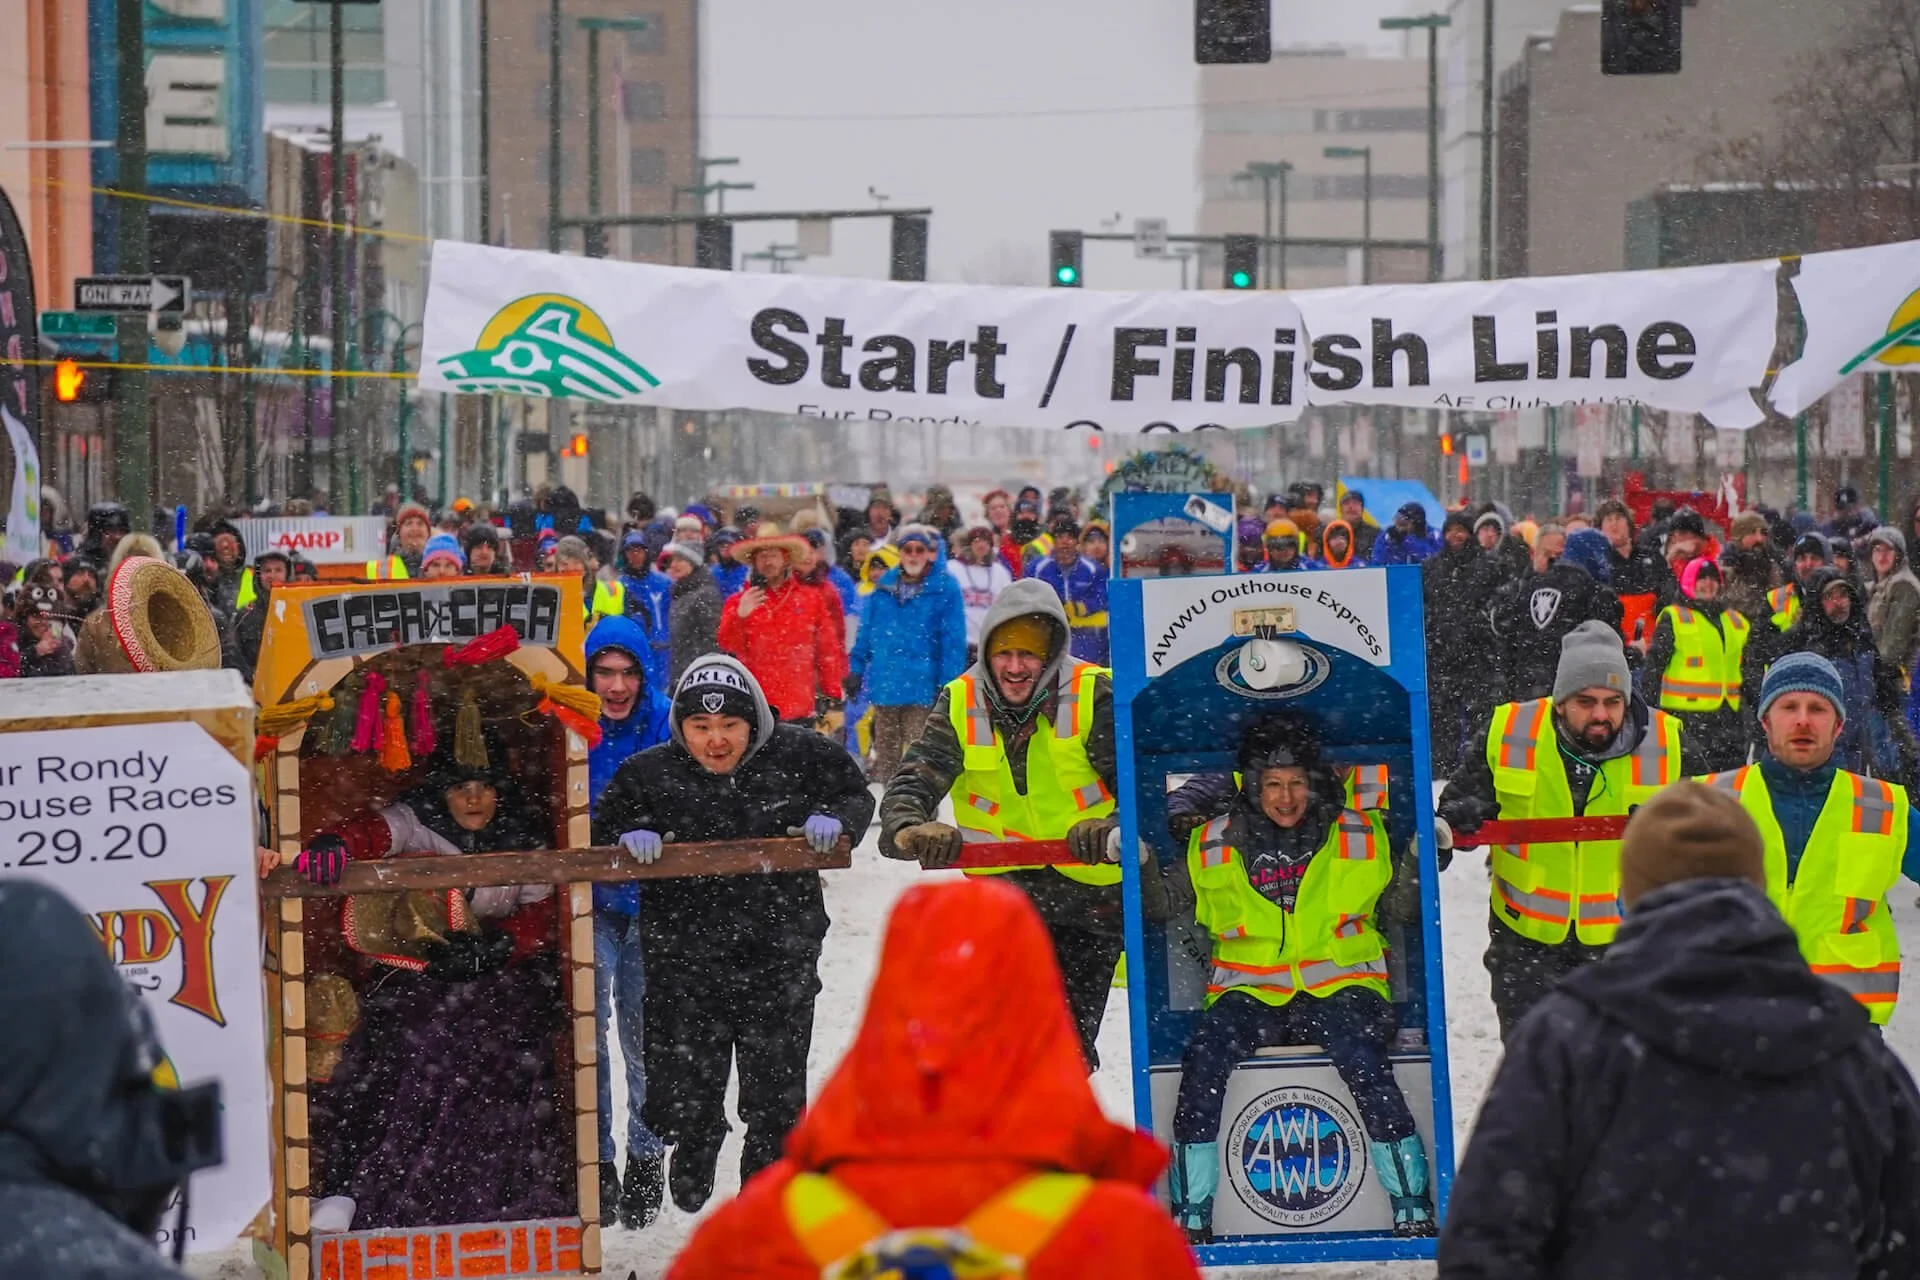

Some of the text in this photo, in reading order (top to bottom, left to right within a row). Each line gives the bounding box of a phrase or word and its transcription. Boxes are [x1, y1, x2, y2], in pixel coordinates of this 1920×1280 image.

[746, 307, 1696, 408] Start / Finish Line
[271, 531, 340, 550] AARP
[312, 591, 425, 652] CASA
[1152, 599, 1207, 666] AWWU
[1210, 579, 1312, 604] Outhouse
[1316, 590, 1383, 657] Express
[38, 750, 169, 784] Rondy
[109, 785, 237, 814] Races
[4, 823, 167, 868] .29.20
[1232, 1105, 1261, 1157] ANCHORAGE
[1262, 1093, 1288, 1107] WATER
[1303, 1093, 1349, 1126] WASTEWATER
[1346, 1126, 1360, 1153] UTILITY
[1241, 1180, 1356, 1222] MUNICIPALITY OF ANCHORAGE
